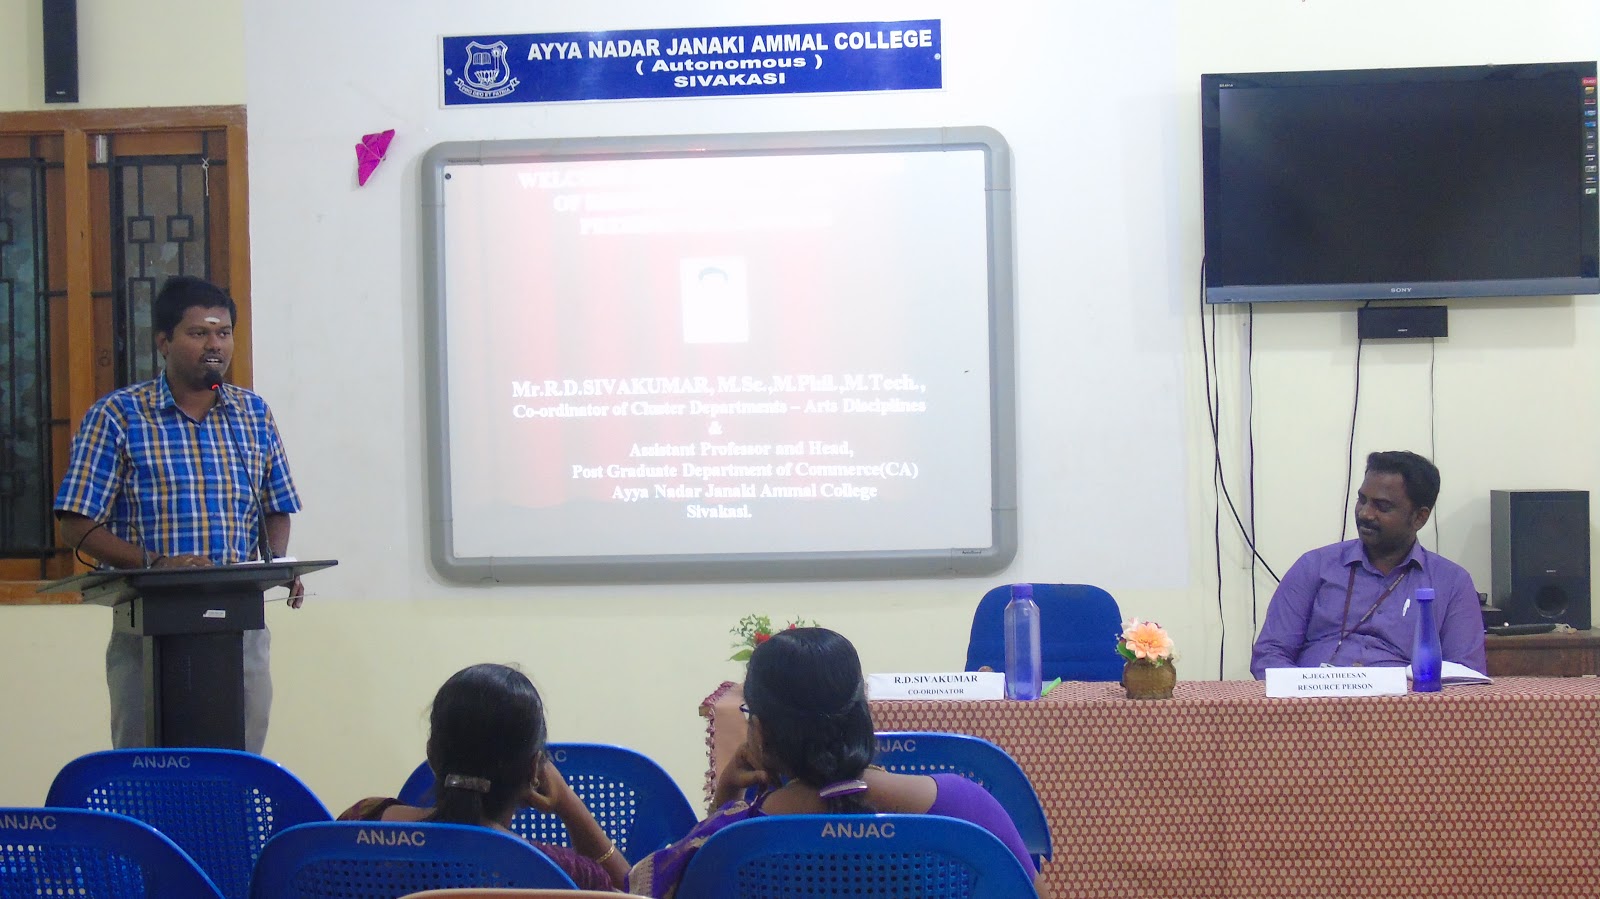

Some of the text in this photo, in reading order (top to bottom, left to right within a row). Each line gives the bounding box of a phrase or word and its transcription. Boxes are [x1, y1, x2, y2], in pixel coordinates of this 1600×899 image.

[527, 29, 932, 61] AYYA NADAR JANAKI AMMAL COLLEGE
[651, 56, 807, 72] Autonomous
[673, 72, 786, 88] SIVAKASI
[512, 404, 609, 419] Co-ordinator
[612, 401, 629, 417] of
[689, 400, 787, 417] Departments
[804, 400, 838, 413] Arts
[700, 441, 771, 456] Professor
[775, 441, 804, 456] and
[808, 440, 854, 458] Head,
[572, 462, 919, 480] Post Graduate Department of Commerce(CA)
[612, 483, 878, 502] Ayya Nadar Janaki Ammal College
[686, 504, 753, 519] Sivakasi.
[894, 675, 978, 684] R.D.SIVAKUMAR
[1302, 672, 1367, 680] K.JEGATHEESAN
[132, 755, 191, 769] ANJAC
[356, 829, 426, 846] ANJAC
[821, 822, 896, 838] ANJAC
